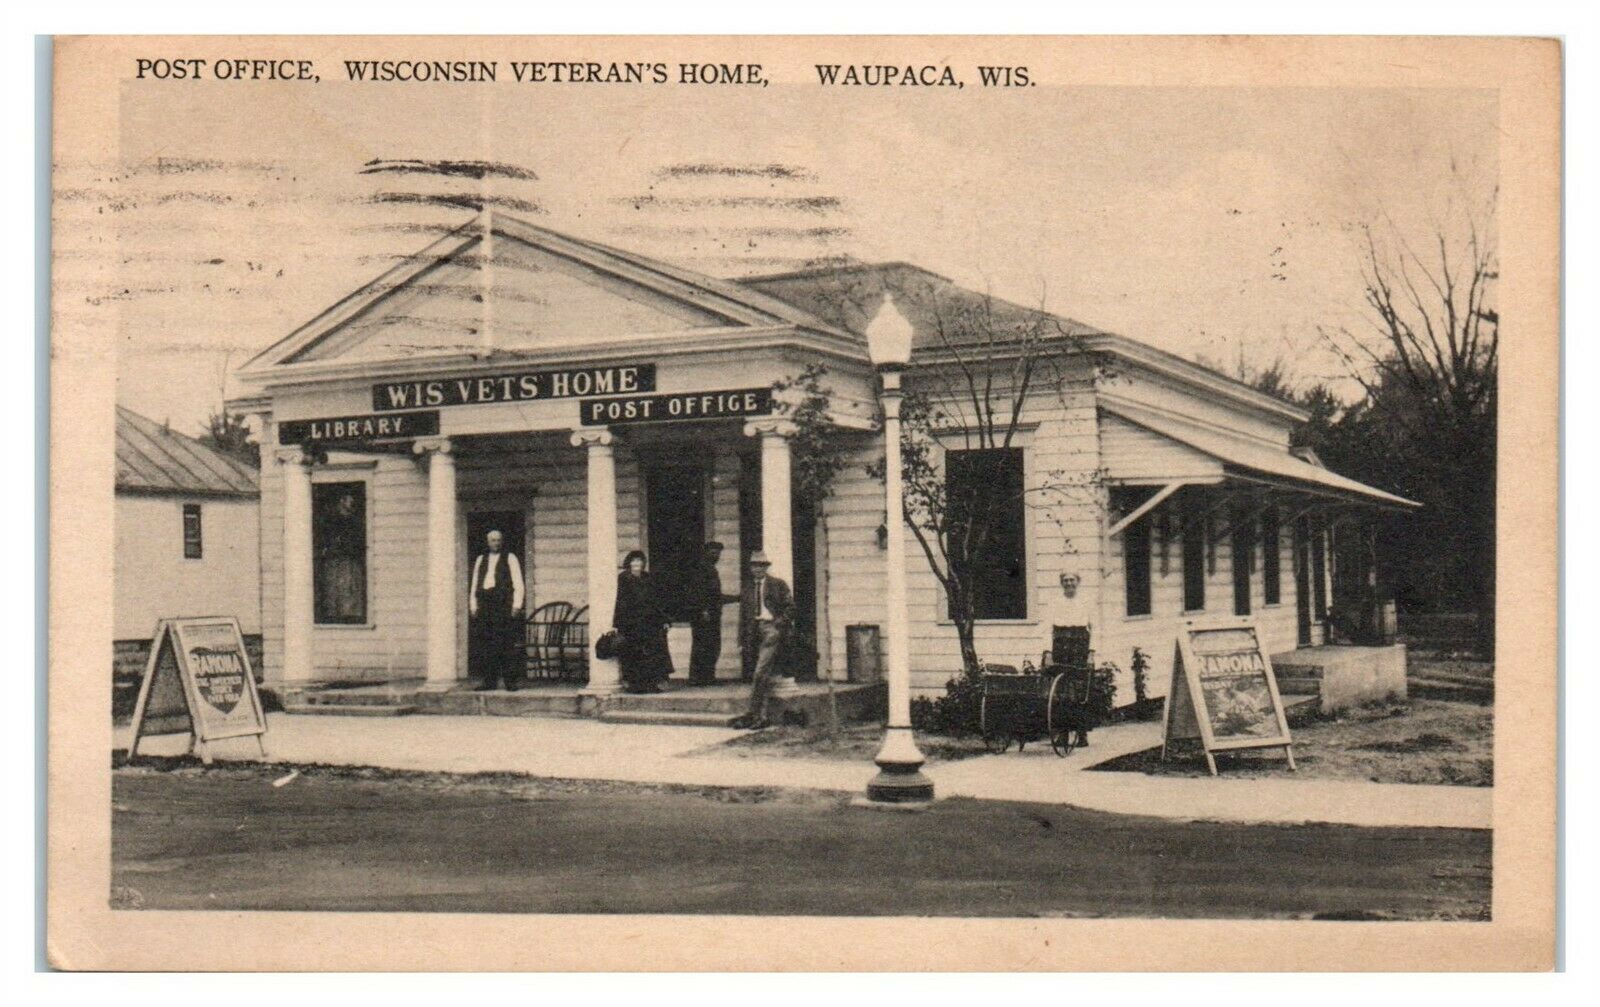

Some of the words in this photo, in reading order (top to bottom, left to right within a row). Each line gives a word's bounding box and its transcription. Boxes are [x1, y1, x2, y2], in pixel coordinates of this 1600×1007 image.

[387, 382, 444, 408] WIS
[551, 367, 638, 397] HOME
[592, 400, 653, 420] POST
[668, 393, 758, 415] OFFICE
[311, 417, 403, 439] LIBRARY
